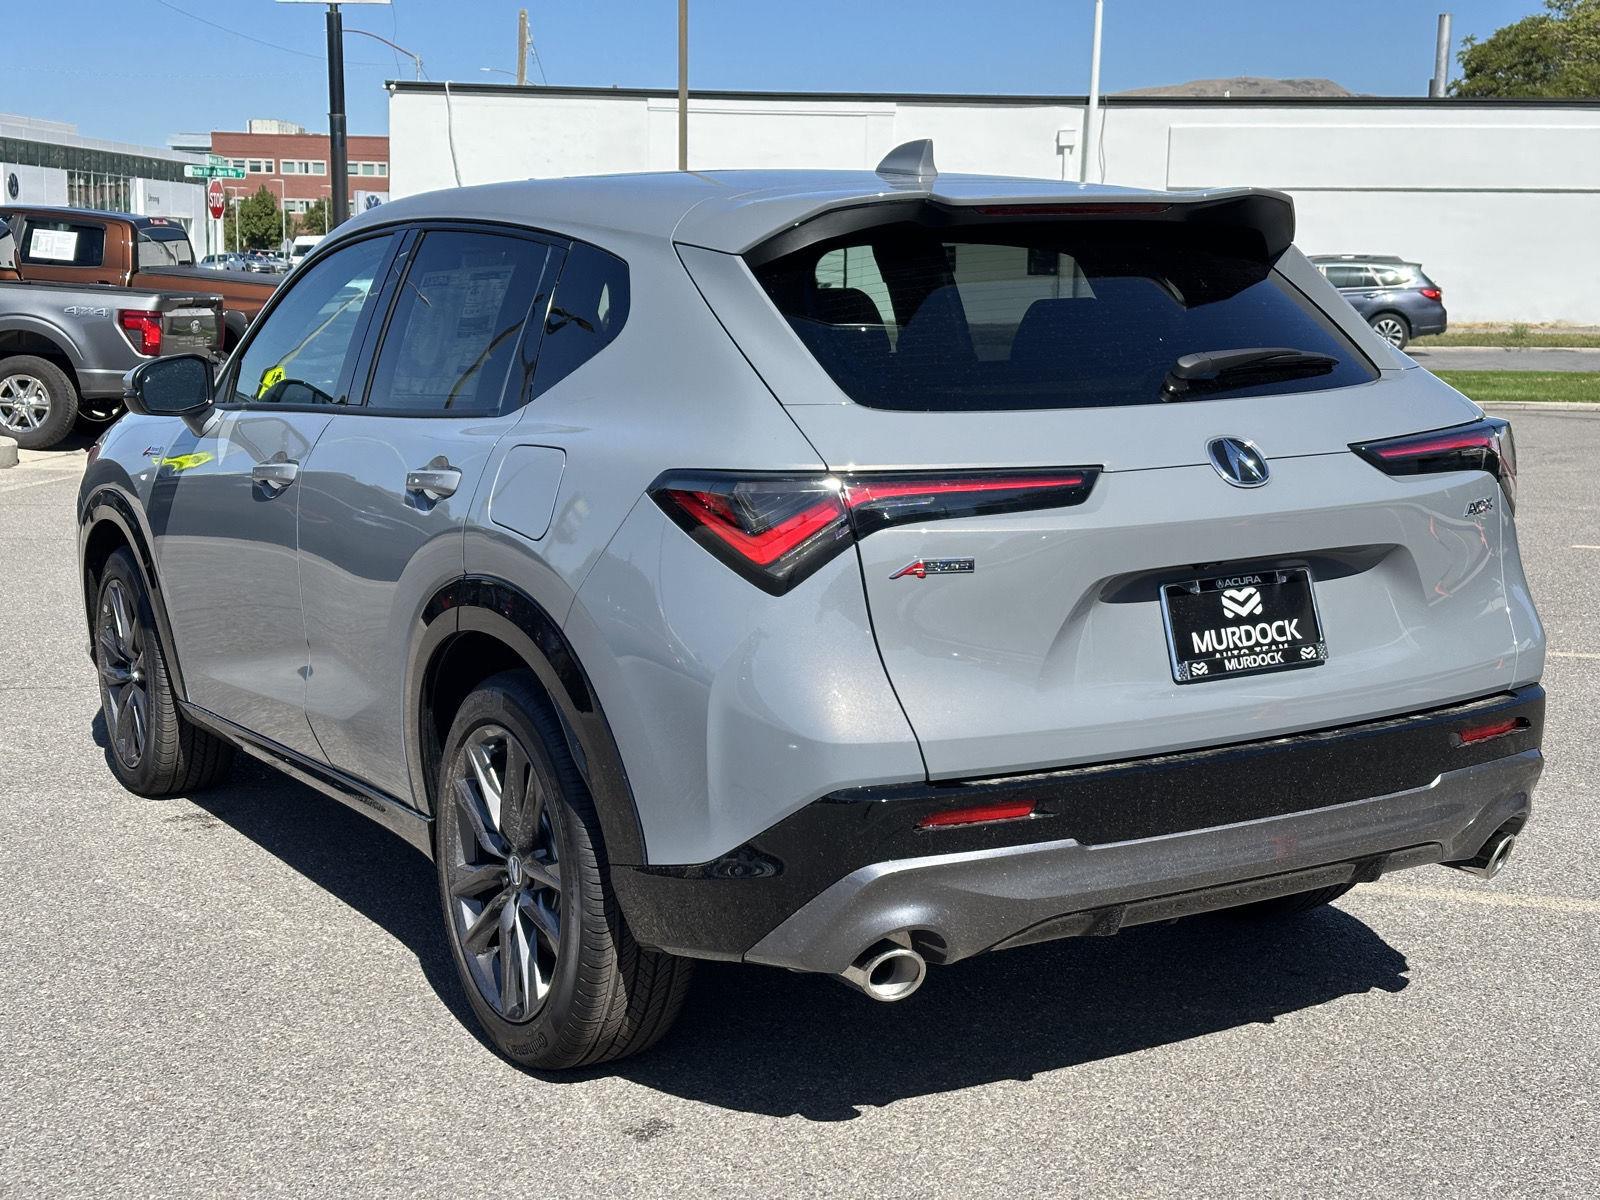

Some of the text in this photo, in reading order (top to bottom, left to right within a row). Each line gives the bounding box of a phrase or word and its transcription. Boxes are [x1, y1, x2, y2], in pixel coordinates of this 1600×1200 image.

[209, 192, 224, 208] STOP
[1224, 575, 1262, 587] ACURA
[1191, 618, 1303, 653] MURDOCK
[1224, 651, 1285, 671] MURDOCK
